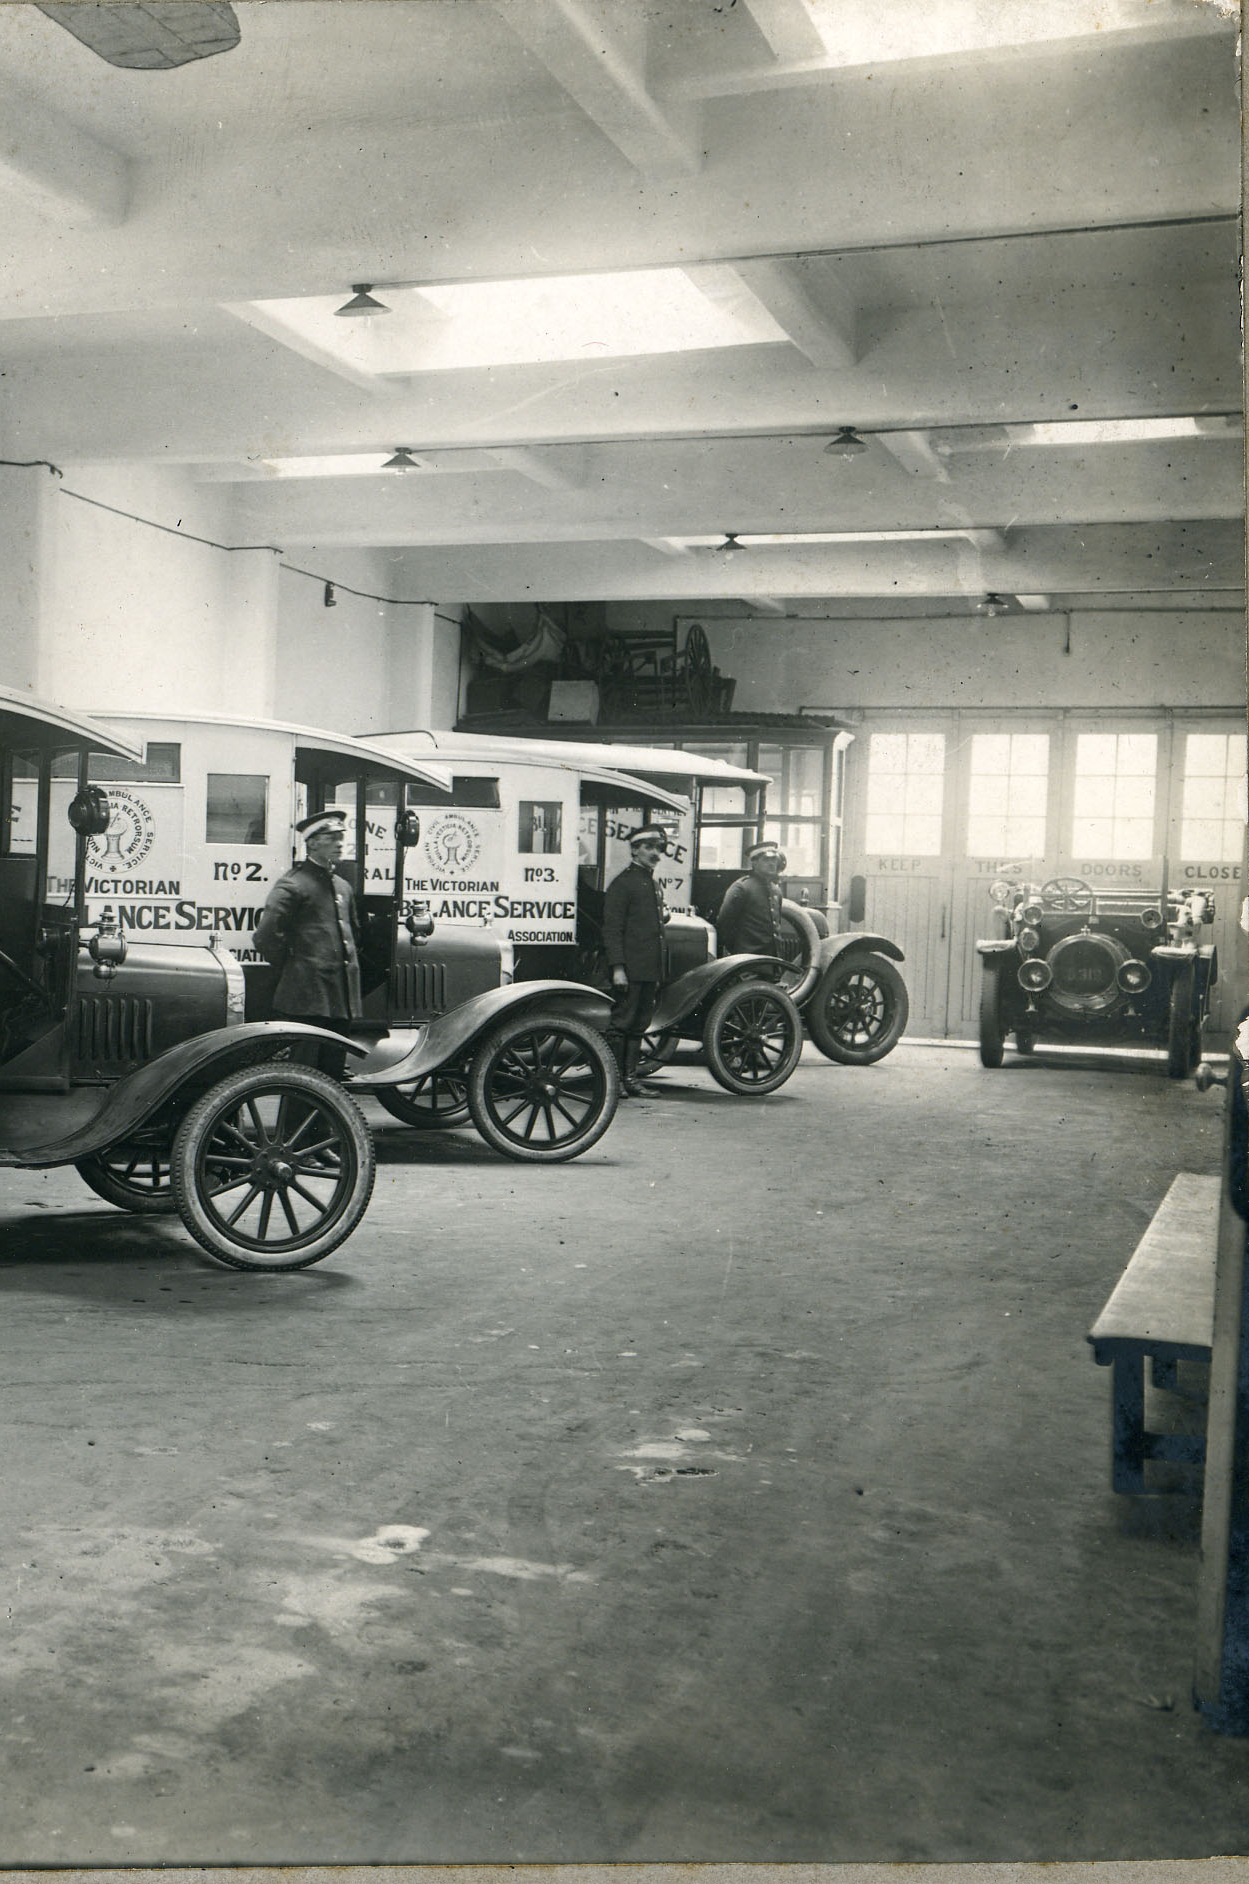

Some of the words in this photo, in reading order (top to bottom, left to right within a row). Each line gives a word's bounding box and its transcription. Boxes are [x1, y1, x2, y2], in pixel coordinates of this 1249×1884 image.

[108, 790, 152, 823] MBULANCE
[879, 859, 921, 872] KEEP
[975, 861, 1022, 874] THES
[1082, 863, 1142, 878] DOORS
[1185, 866, 1241, 879] CLOSE
[84, 877, 180, 896] VICTORIAN
[405, 878, 428, 892] THE
[430, 879, 499, 893] VICTORIAN
[494, 896, 575, 919] SERVICE
[175, 901, 264, 931] SERVIC
